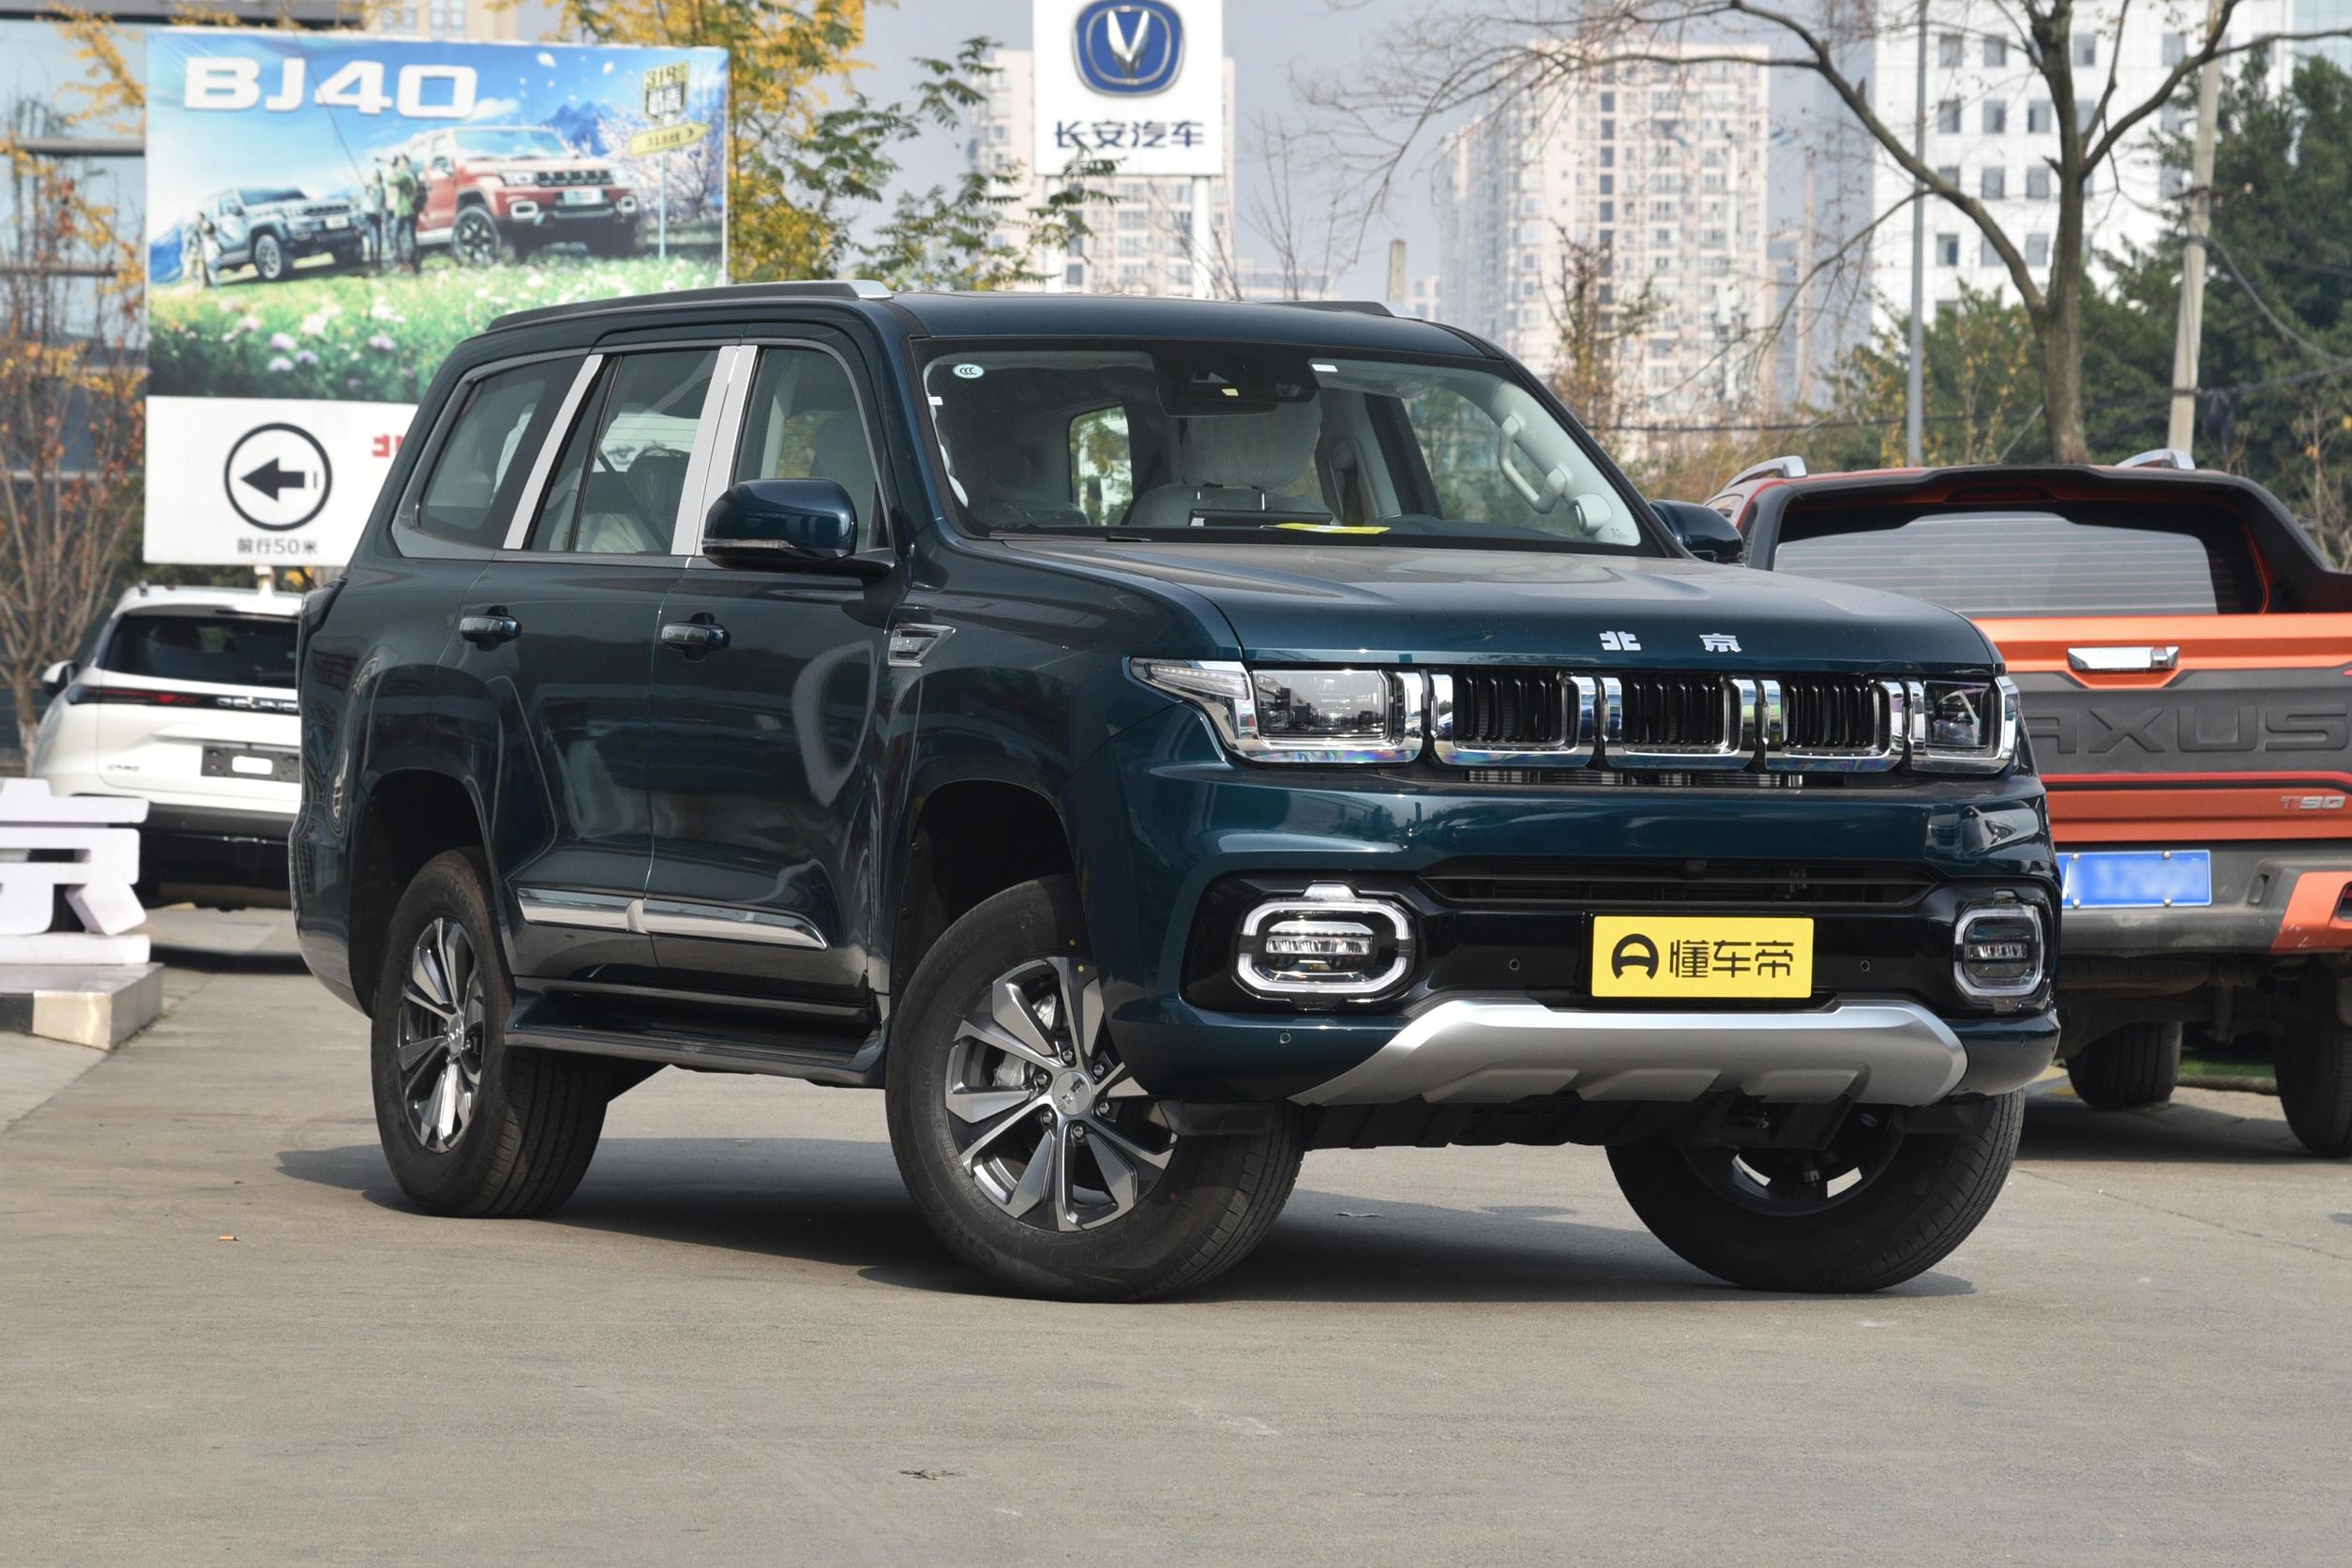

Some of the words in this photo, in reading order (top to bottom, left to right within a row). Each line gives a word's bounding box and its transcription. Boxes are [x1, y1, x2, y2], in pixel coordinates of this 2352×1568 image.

[184, 56, 478, 118] BJ40
[1056, 119, 1204, 148] 长安汽车
[237, 537, 318, 555] 前行50米
[2280, 795, 2347, 811] T90
[1669, 939, 1795, 979] 懂车帝
